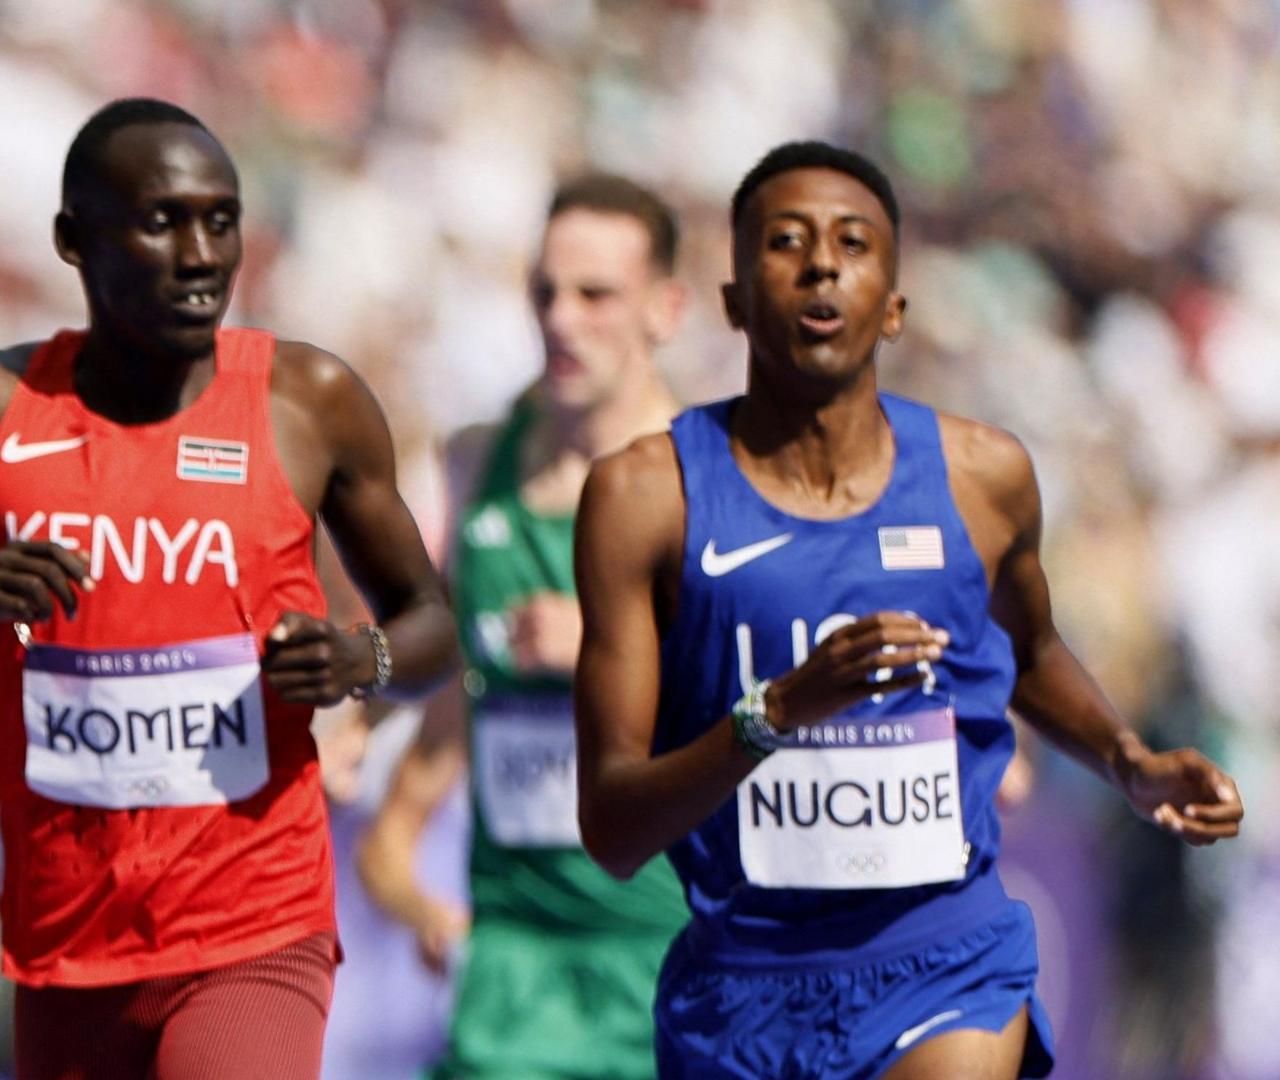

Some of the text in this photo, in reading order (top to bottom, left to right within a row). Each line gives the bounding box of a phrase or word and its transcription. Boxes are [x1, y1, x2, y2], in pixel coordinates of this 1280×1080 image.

[76, 650, 196, 673] PARIS 2024
[43, 699, 246, 754] KOMEN
[797, 722, 915, 745] PARIS 2024
[750, 772, 953, 828] NUGUSE
